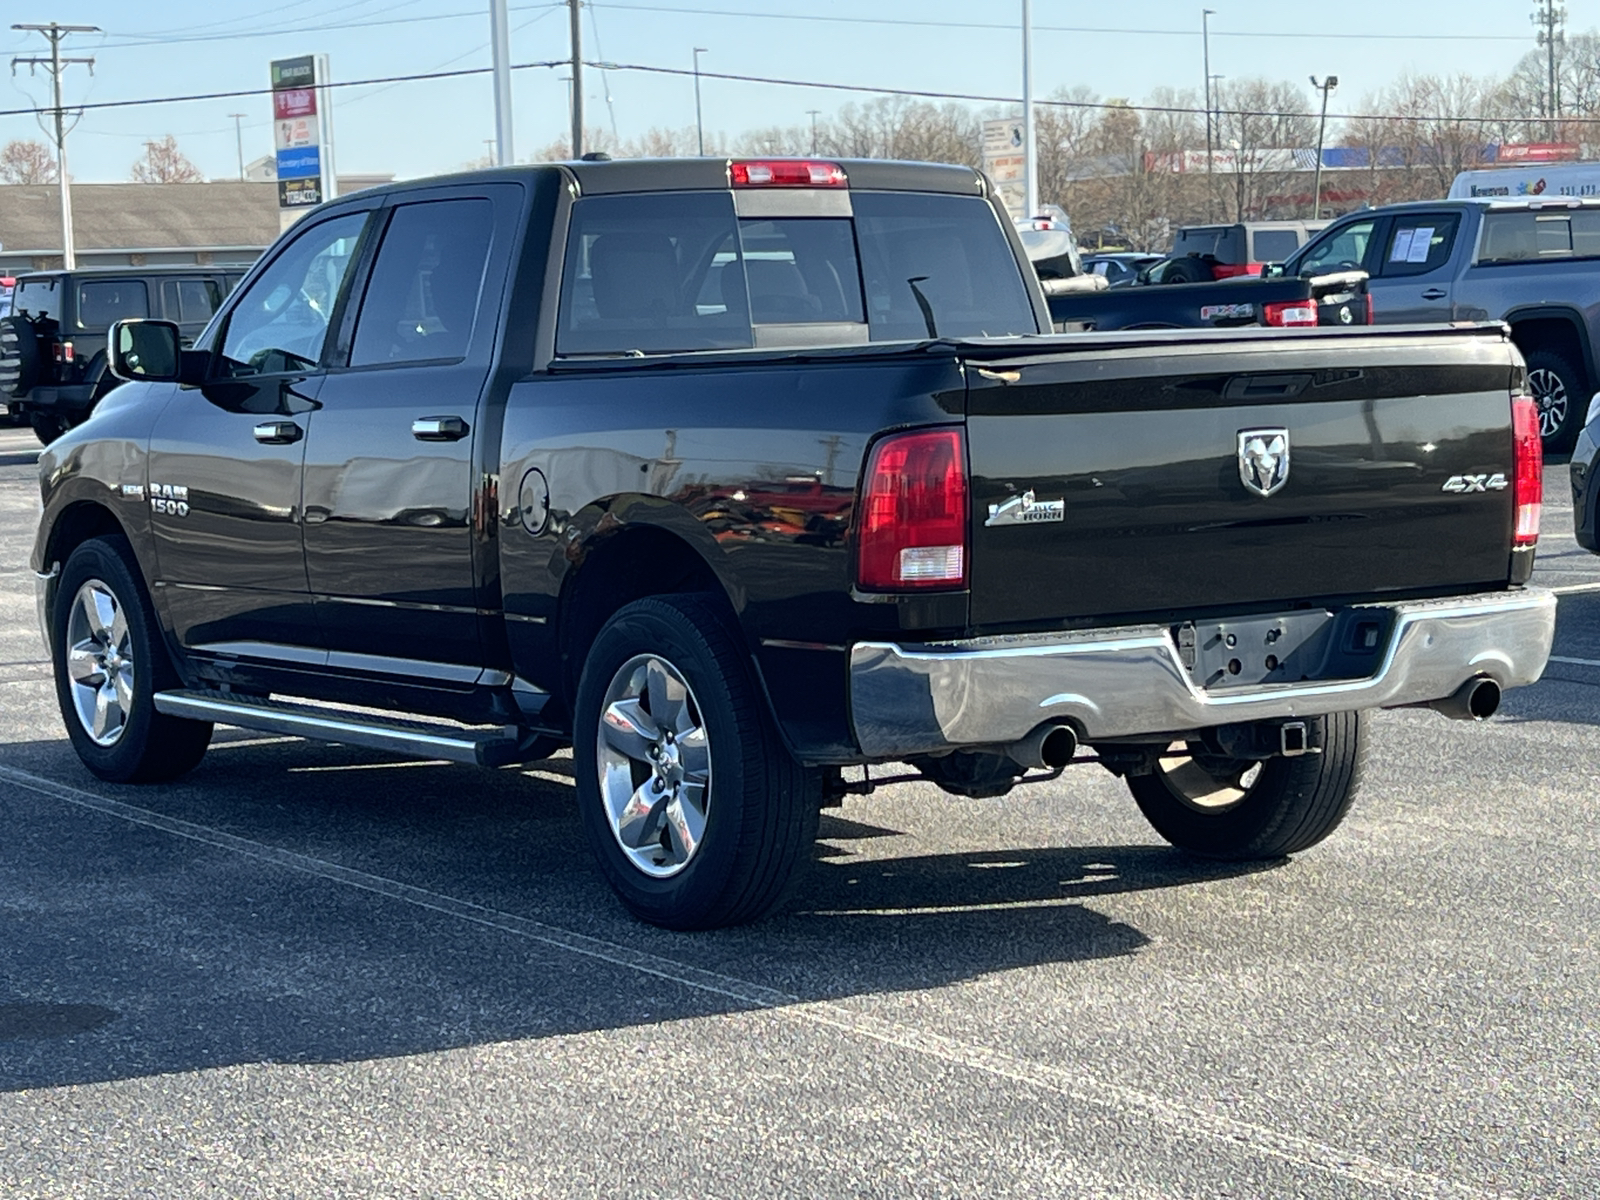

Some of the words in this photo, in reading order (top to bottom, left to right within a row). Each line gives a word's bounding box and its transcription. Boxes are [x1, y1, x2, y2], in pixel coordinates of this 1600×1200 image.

[1201, 303, 1253, 320] FX4
[150, 482, 188, 501] RAM
[150, 498, 190, 516] 1500
[1023, 511, 1061, 521] HORN
